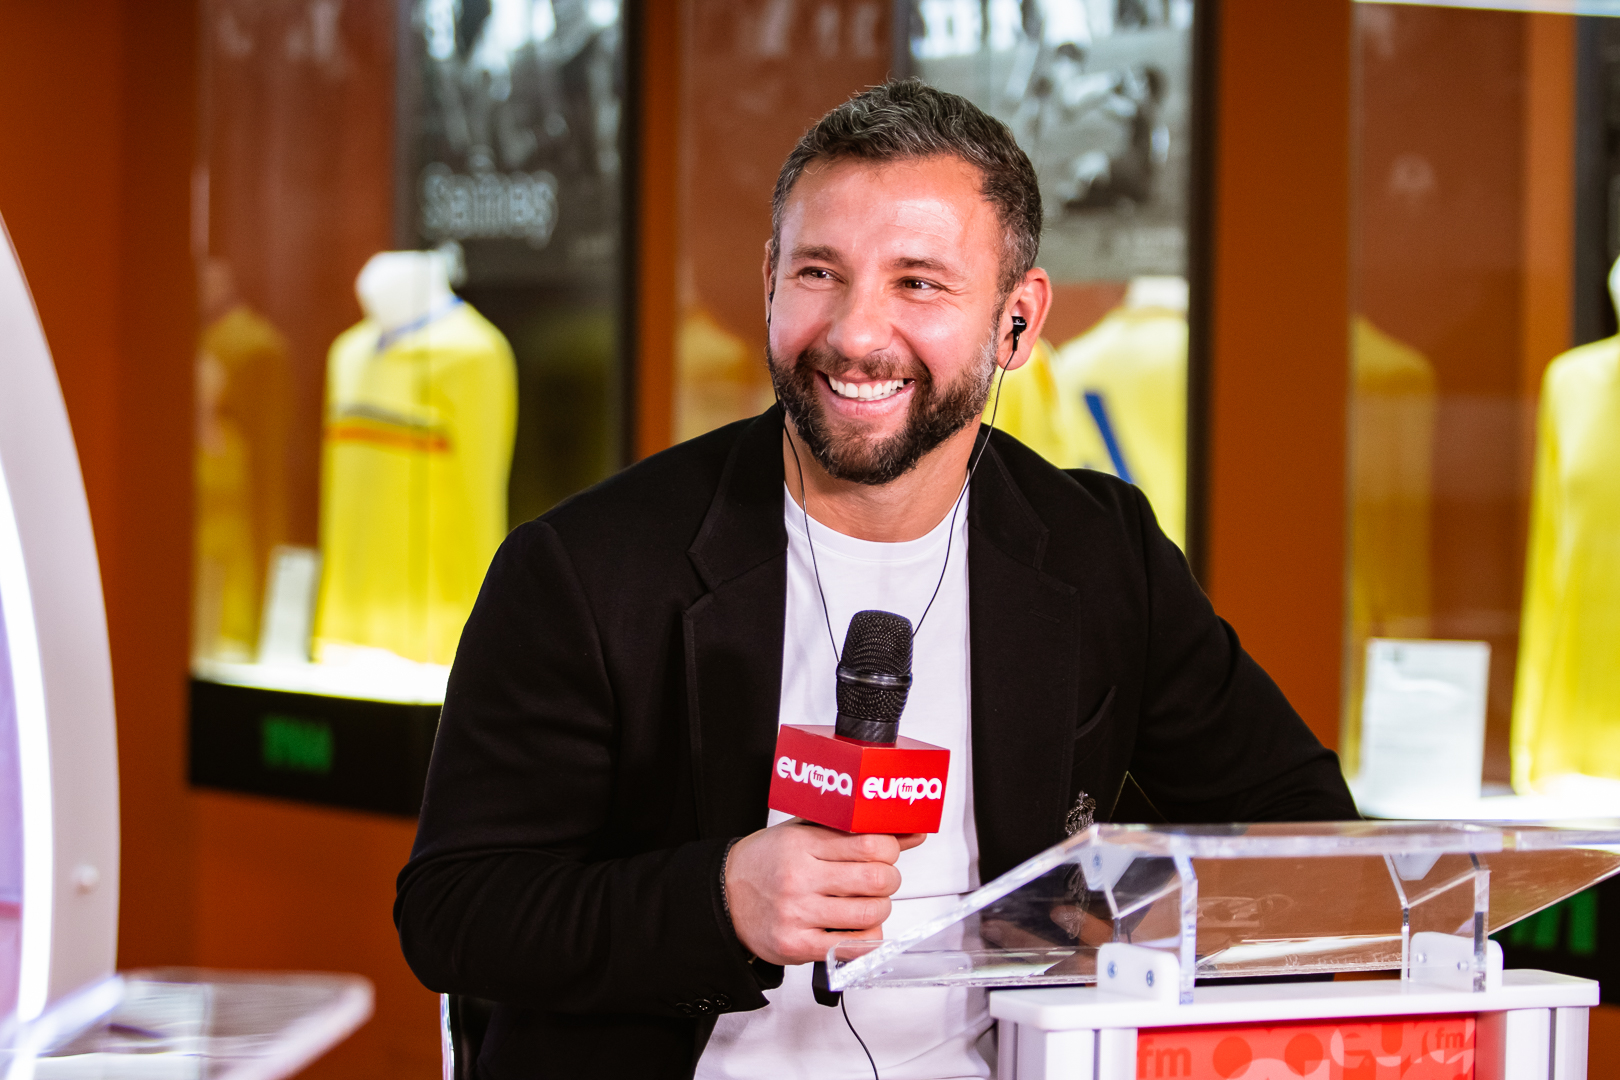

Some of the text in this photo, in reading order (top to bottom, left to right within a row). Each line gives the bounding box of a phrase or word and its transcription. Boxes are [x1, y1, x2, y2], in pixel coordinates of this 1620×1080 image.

[776, 756, 853, 796] europa fm
[863, 777, 943, 805] europa fm
[1435, 1027, 1465, 1049] fm
[1138, 1037, 1192, 1079] fm
